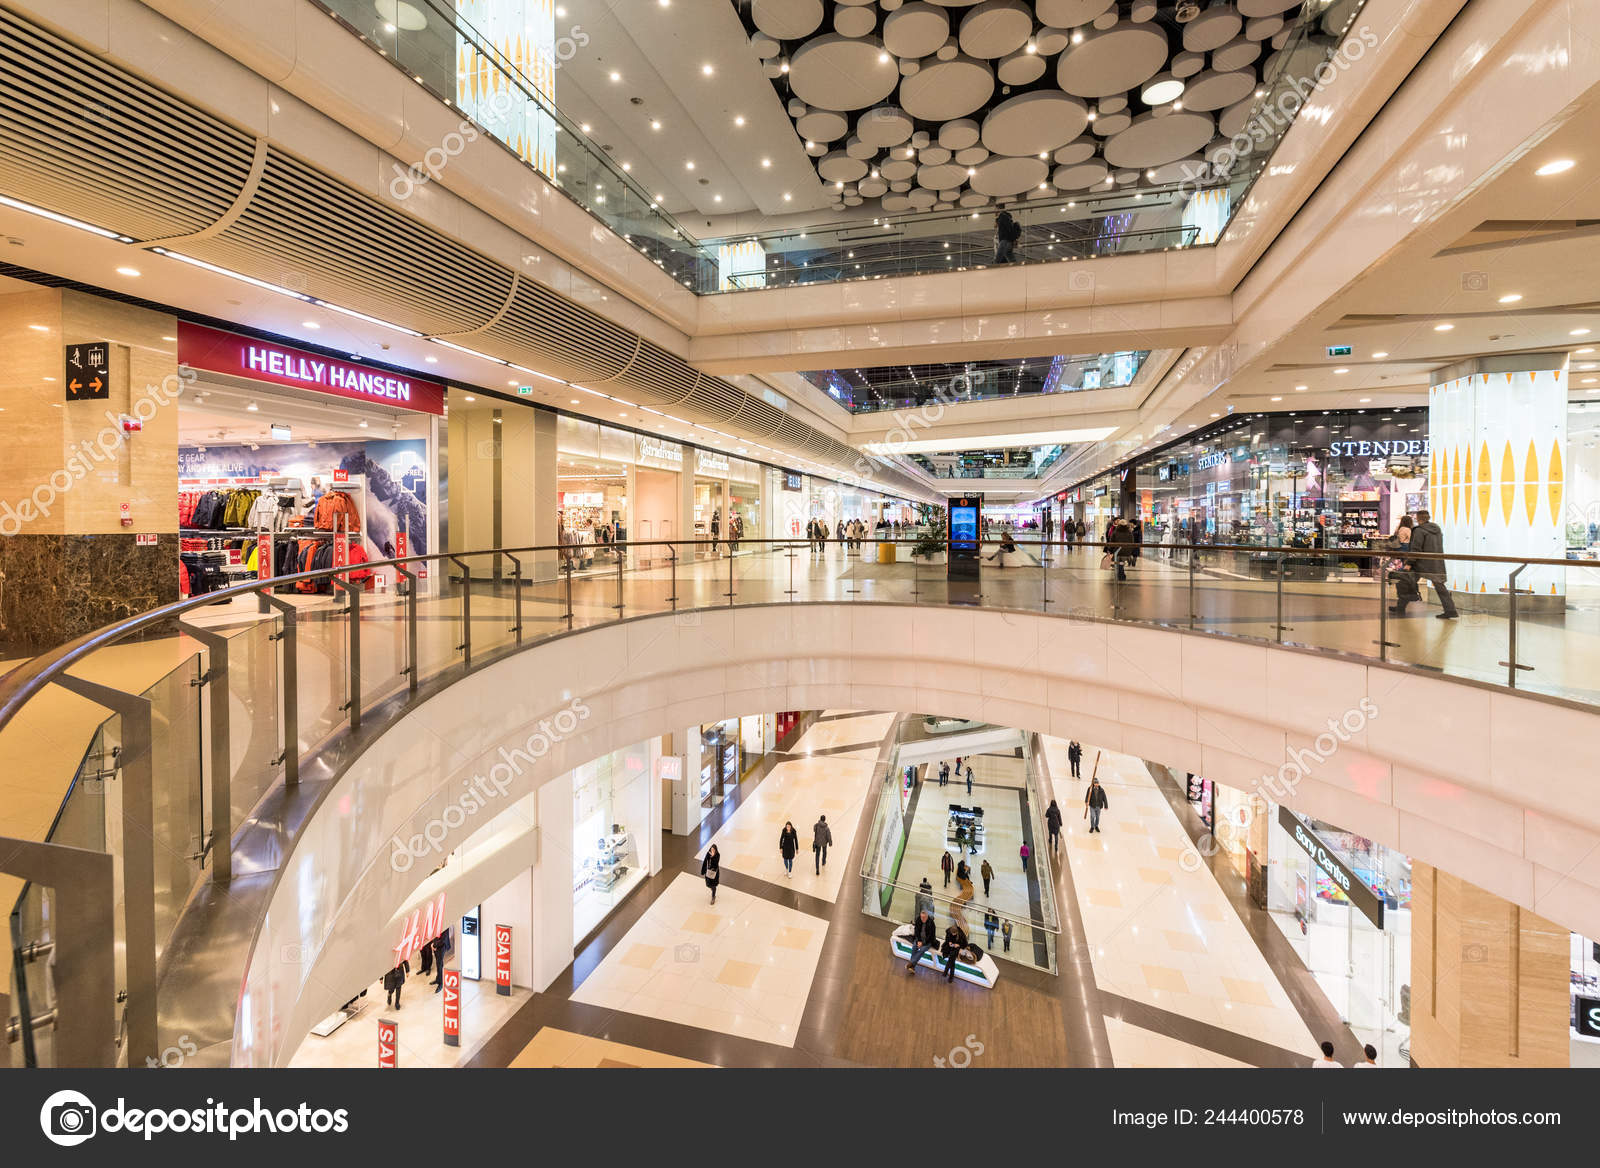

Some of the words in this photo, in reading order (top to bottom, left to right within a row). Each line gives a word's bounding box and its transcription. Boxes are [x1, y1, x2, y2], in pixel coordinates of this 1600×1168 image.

[249, 346, 326, 383] HELLY
[330, 365, 411, 401] HANSEN
[1295, 824, 1317, 858] Sony
[1317, 847, 1350, 891] Centre
[497, 930, 510, 981] SALE
[444, 974, 458, 1030] SALE
